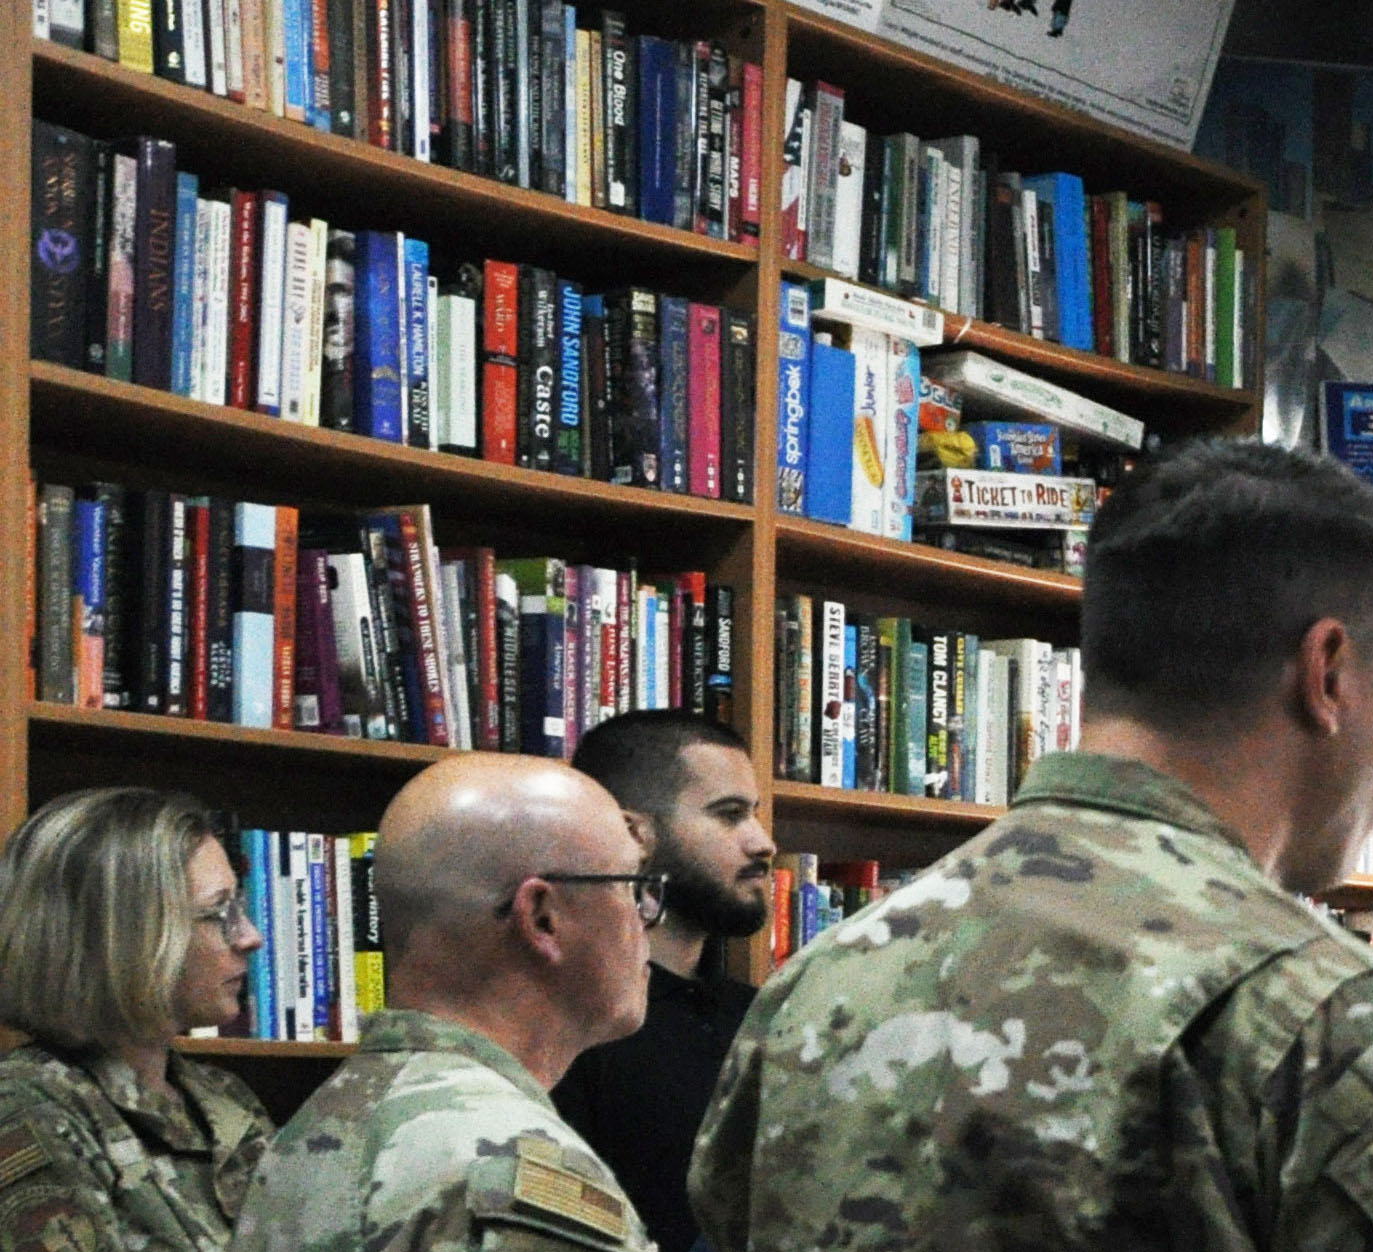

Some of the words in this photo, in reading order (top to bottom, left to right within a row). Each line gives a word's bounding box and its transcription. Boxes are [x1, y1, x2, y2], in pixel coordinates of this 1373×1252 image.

[613, 50, 627, 81] One
[613, 83, 627, 127] Blood
[729, 156, 740, 198] MAPS
[149, 208, 171, 312] INDIANS
[411, 262, 424, 307] LAURELL
[536, 289, 548, 348] Wilkerson
[562, 286, 581, 334] JOHN
[411, 323, 425, 377] HAMILTON
[535, 365, 556, 439] Caste
[560, 337, 580, 426] SANDFORD
[859, 363, 878, 417] Junior
[783, 362, 806, 465] springbok
[964, 478, 1018, 508] TICKET
[1034, 481, 1068, 509] RIDE
[407, 541, 426, 601] STRANGERS
[416, 604, 428, 617] TO
[828, 606, 842, 648] STEVE
[418, 620, 433, 650] THESE
[718, 617, 732, 672] SANDFORD
[932, 635, 948, 667] TOM
[423, 652, 441, 693] SHORES
[503, 626, 519, 703] MIDDLESEX
[827, 653, 841, 699] BERRY
[932, 670, 948, 727] CLANCY
[823, 728, 833, 757] AFFAIR
